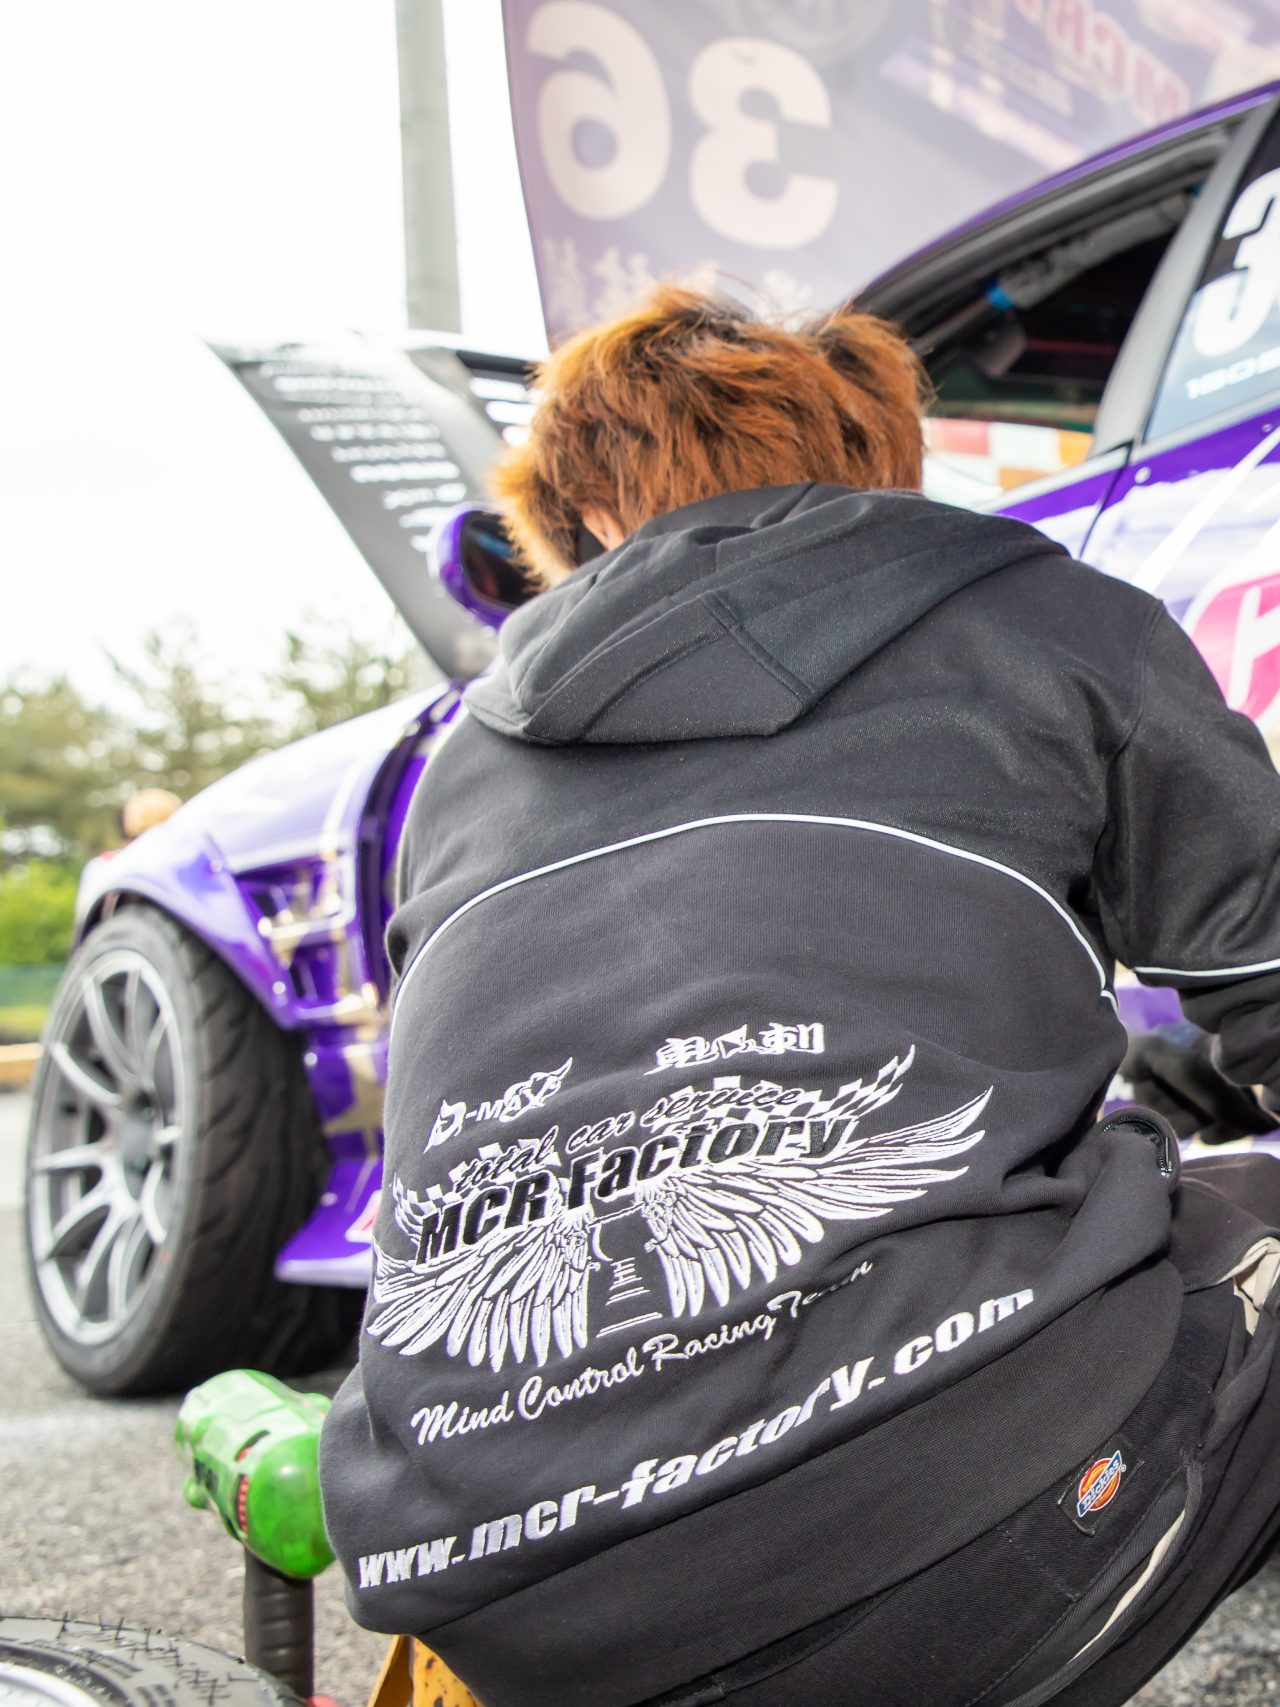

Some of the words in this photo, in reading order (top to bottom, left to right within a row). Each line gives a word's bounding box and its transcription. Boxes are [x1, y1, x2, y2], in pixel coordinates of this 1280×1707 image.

[414, 1168, 556, 1267] MCR
[567, 1116, 859, 1211] Factory
[456, 1124, 559, 1193] total
[566, 1111, 635, 1154] car
[640, 1087, 804, 1128] service
[358, 1287, 1034, 1590] www.mcr-factory.com
[411, 1401, 514, 1446] Mind
[518, 1346, 646, 1422] Control
[642, 1314, 777, 1372] Racing
